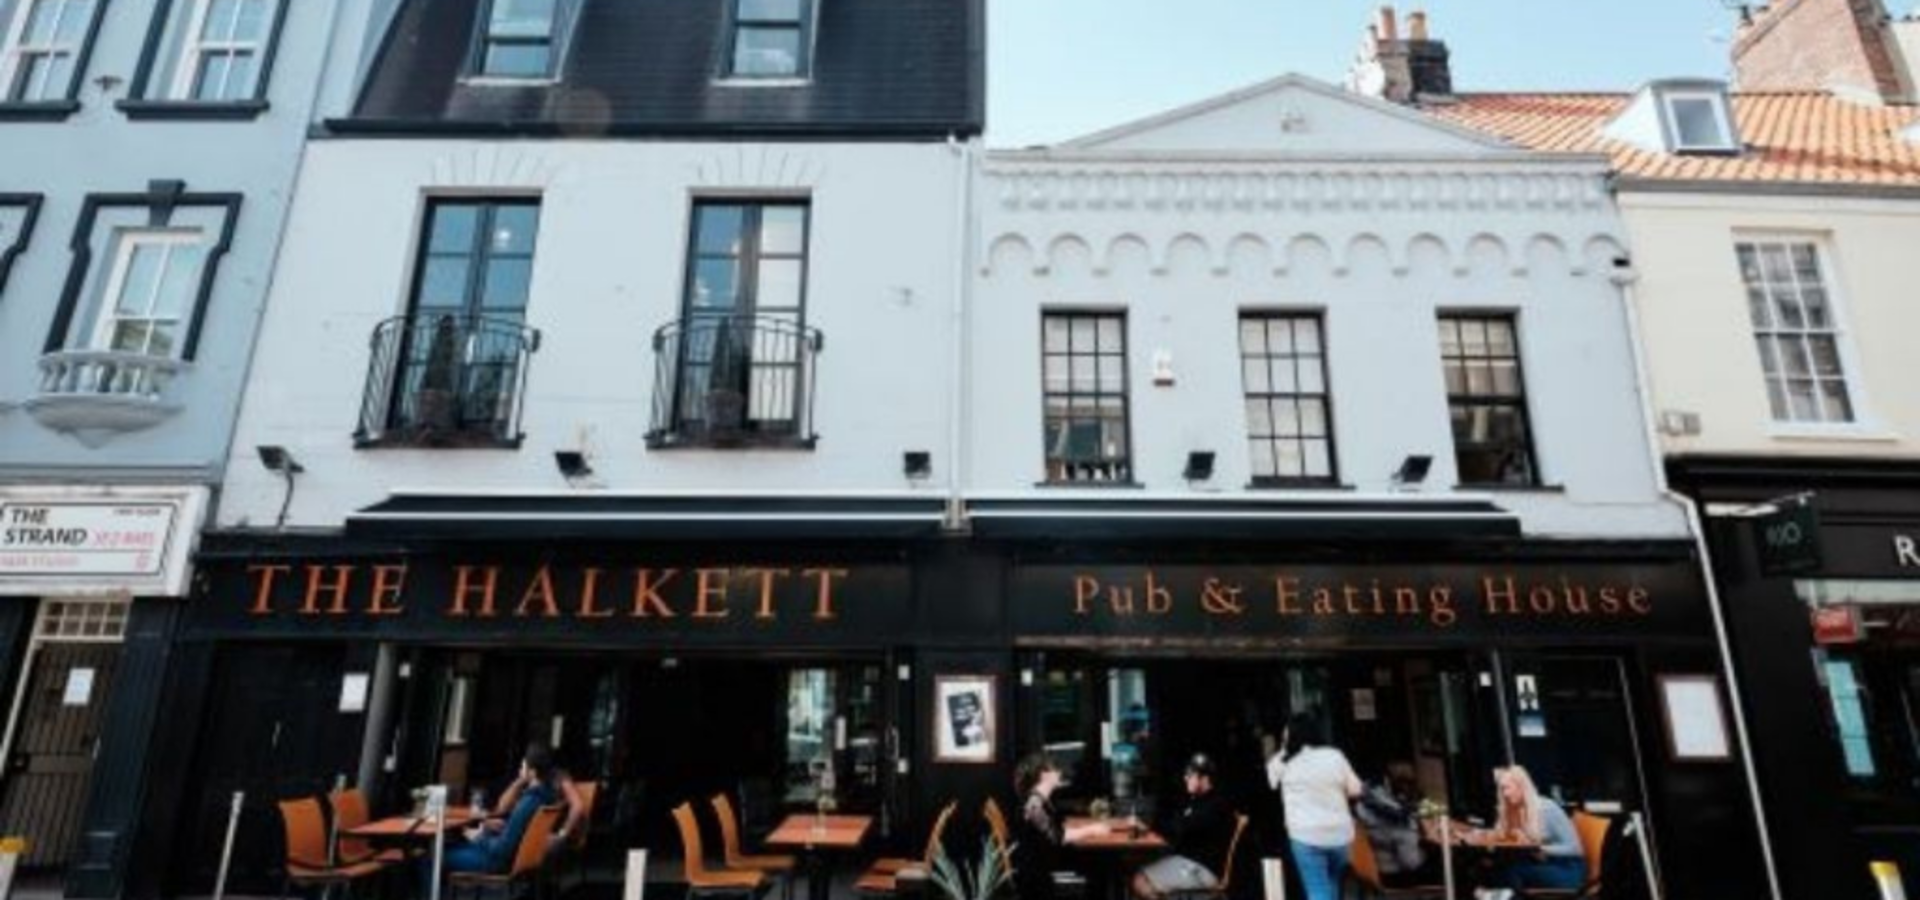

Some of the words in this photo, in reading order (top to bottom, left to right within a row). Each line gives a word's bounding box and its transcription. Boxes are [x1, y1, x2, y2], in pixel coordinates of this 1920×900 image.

[11, 508, 48, 524] THE
[4, 528, 87, 545] STRAND
[248, 564, 408, 615] THE
[449, 564, 849, 619] HALKETT
[1074, 572, 1172, 614] Pub
[1201, 578, 1243, 614] &
[1276, 576, 1456, 624] Eating
[1482, 575, 1652, 614] House
